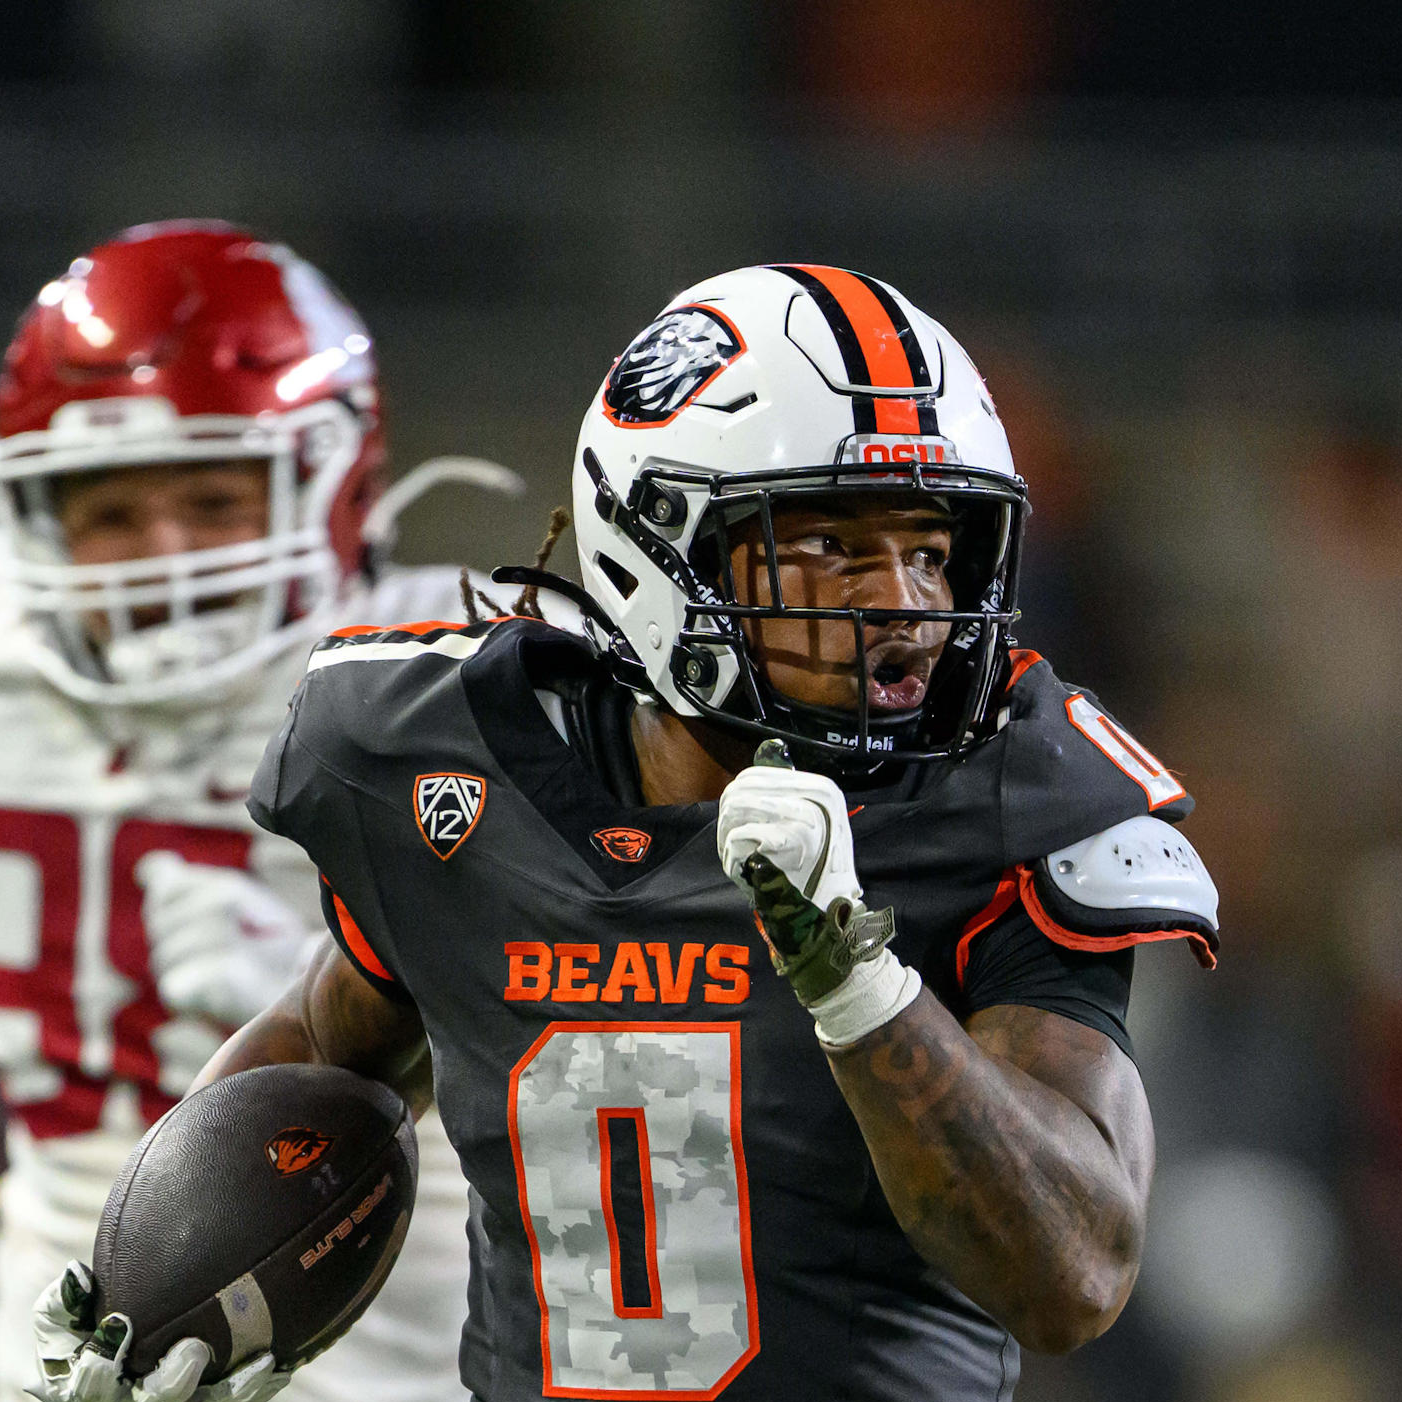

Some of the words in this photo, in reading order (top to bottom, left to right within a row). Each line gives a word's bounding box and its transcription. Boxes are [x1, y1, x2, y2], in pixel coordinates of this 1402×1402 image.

[418, 776, 482, 826] PAC
[430, 809, 463, 840] 12
[503, 941, 751, 1005] BEAVS
[507, 1020, 761, 1402] 0
[299, 1217, 353, 1270] ELITE
